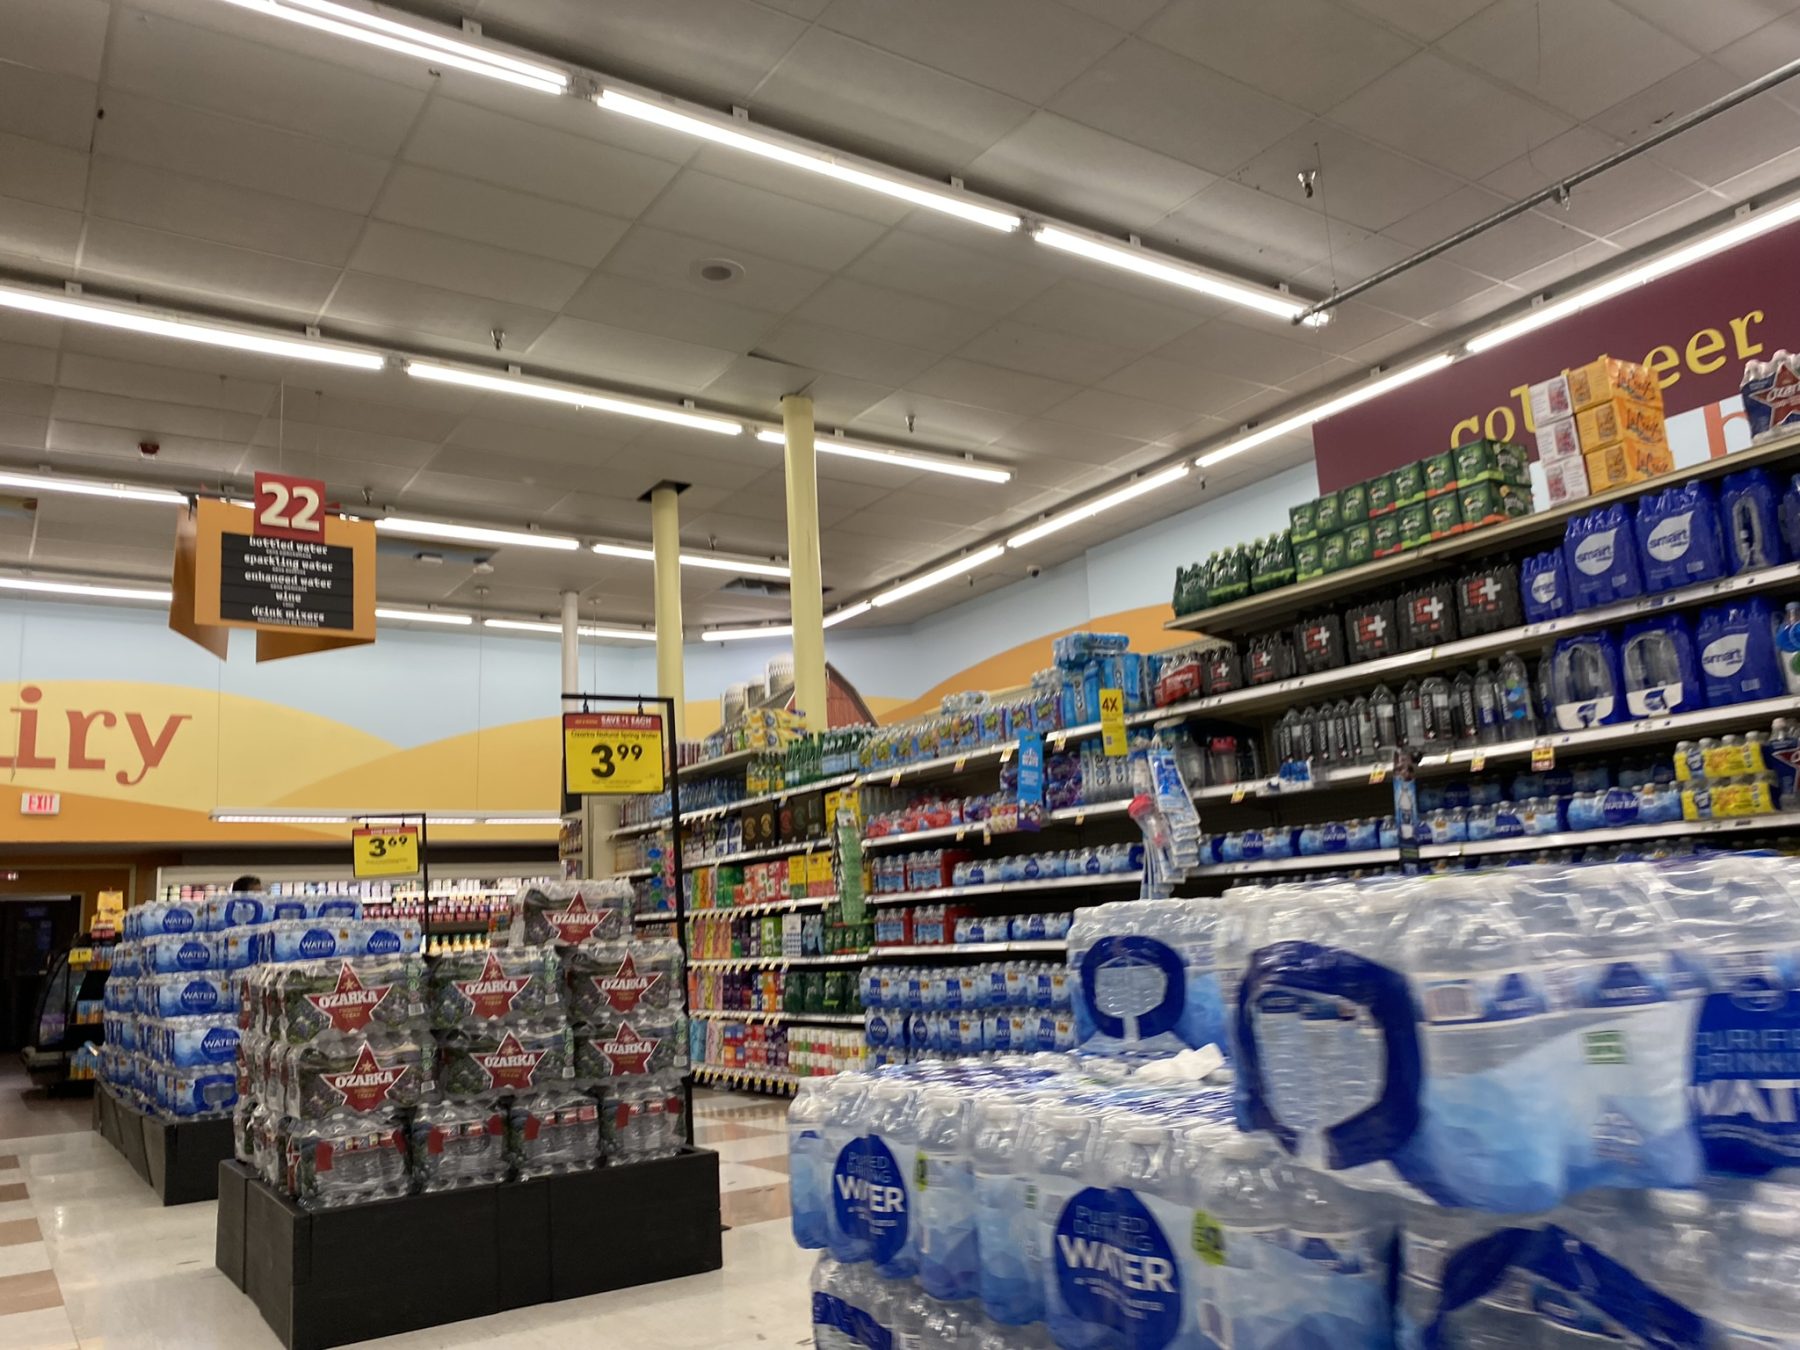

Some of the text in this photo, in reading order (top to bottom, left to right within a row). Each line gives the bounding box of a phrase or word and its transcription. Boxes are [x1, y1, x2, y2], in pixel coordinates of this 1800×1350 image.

[1642, 309, 1765, 390] eer
[1450, 383, 1537, 448] col
[260, 482, 320, 532] 22
[249, 536, 294, 551] bottled
[296, 542, 328, 556] water
[244, 554, 300, 570] sparkling
[301, 560, 333, 573] water
[244, 571, 298, 586] enhanced
[300, 577, 332, 590] water
[275, 591, 302, 604] wine
[252, 605, 282, 618] drink
[285, 609, 325, 622] mixers
[1102, 697, 1119, 713] 4X
[0, 686, 192, 786] iry
[28, 795, 55, 811] EXIT
[164, 916, 193, 926] WATER
[552, 912, 599, 925] OZARKA
[301, 940, 334, 950] WATER
[369, 940, 399, 949] WATER
[178, 950, 209, 960] WATER
[465, 980, 518, 995] OZARKA
[601, 977, 648, 990] OZARKA
[183, 990, 217, 1000] WATER
[318, 989, 378, 1009] OZARKA
[603, 1041, 652, 1055] OZARKA
[484, 1053, 535, 1068] OZARKA
[335, 1070, 393, 1088] OZARKA
